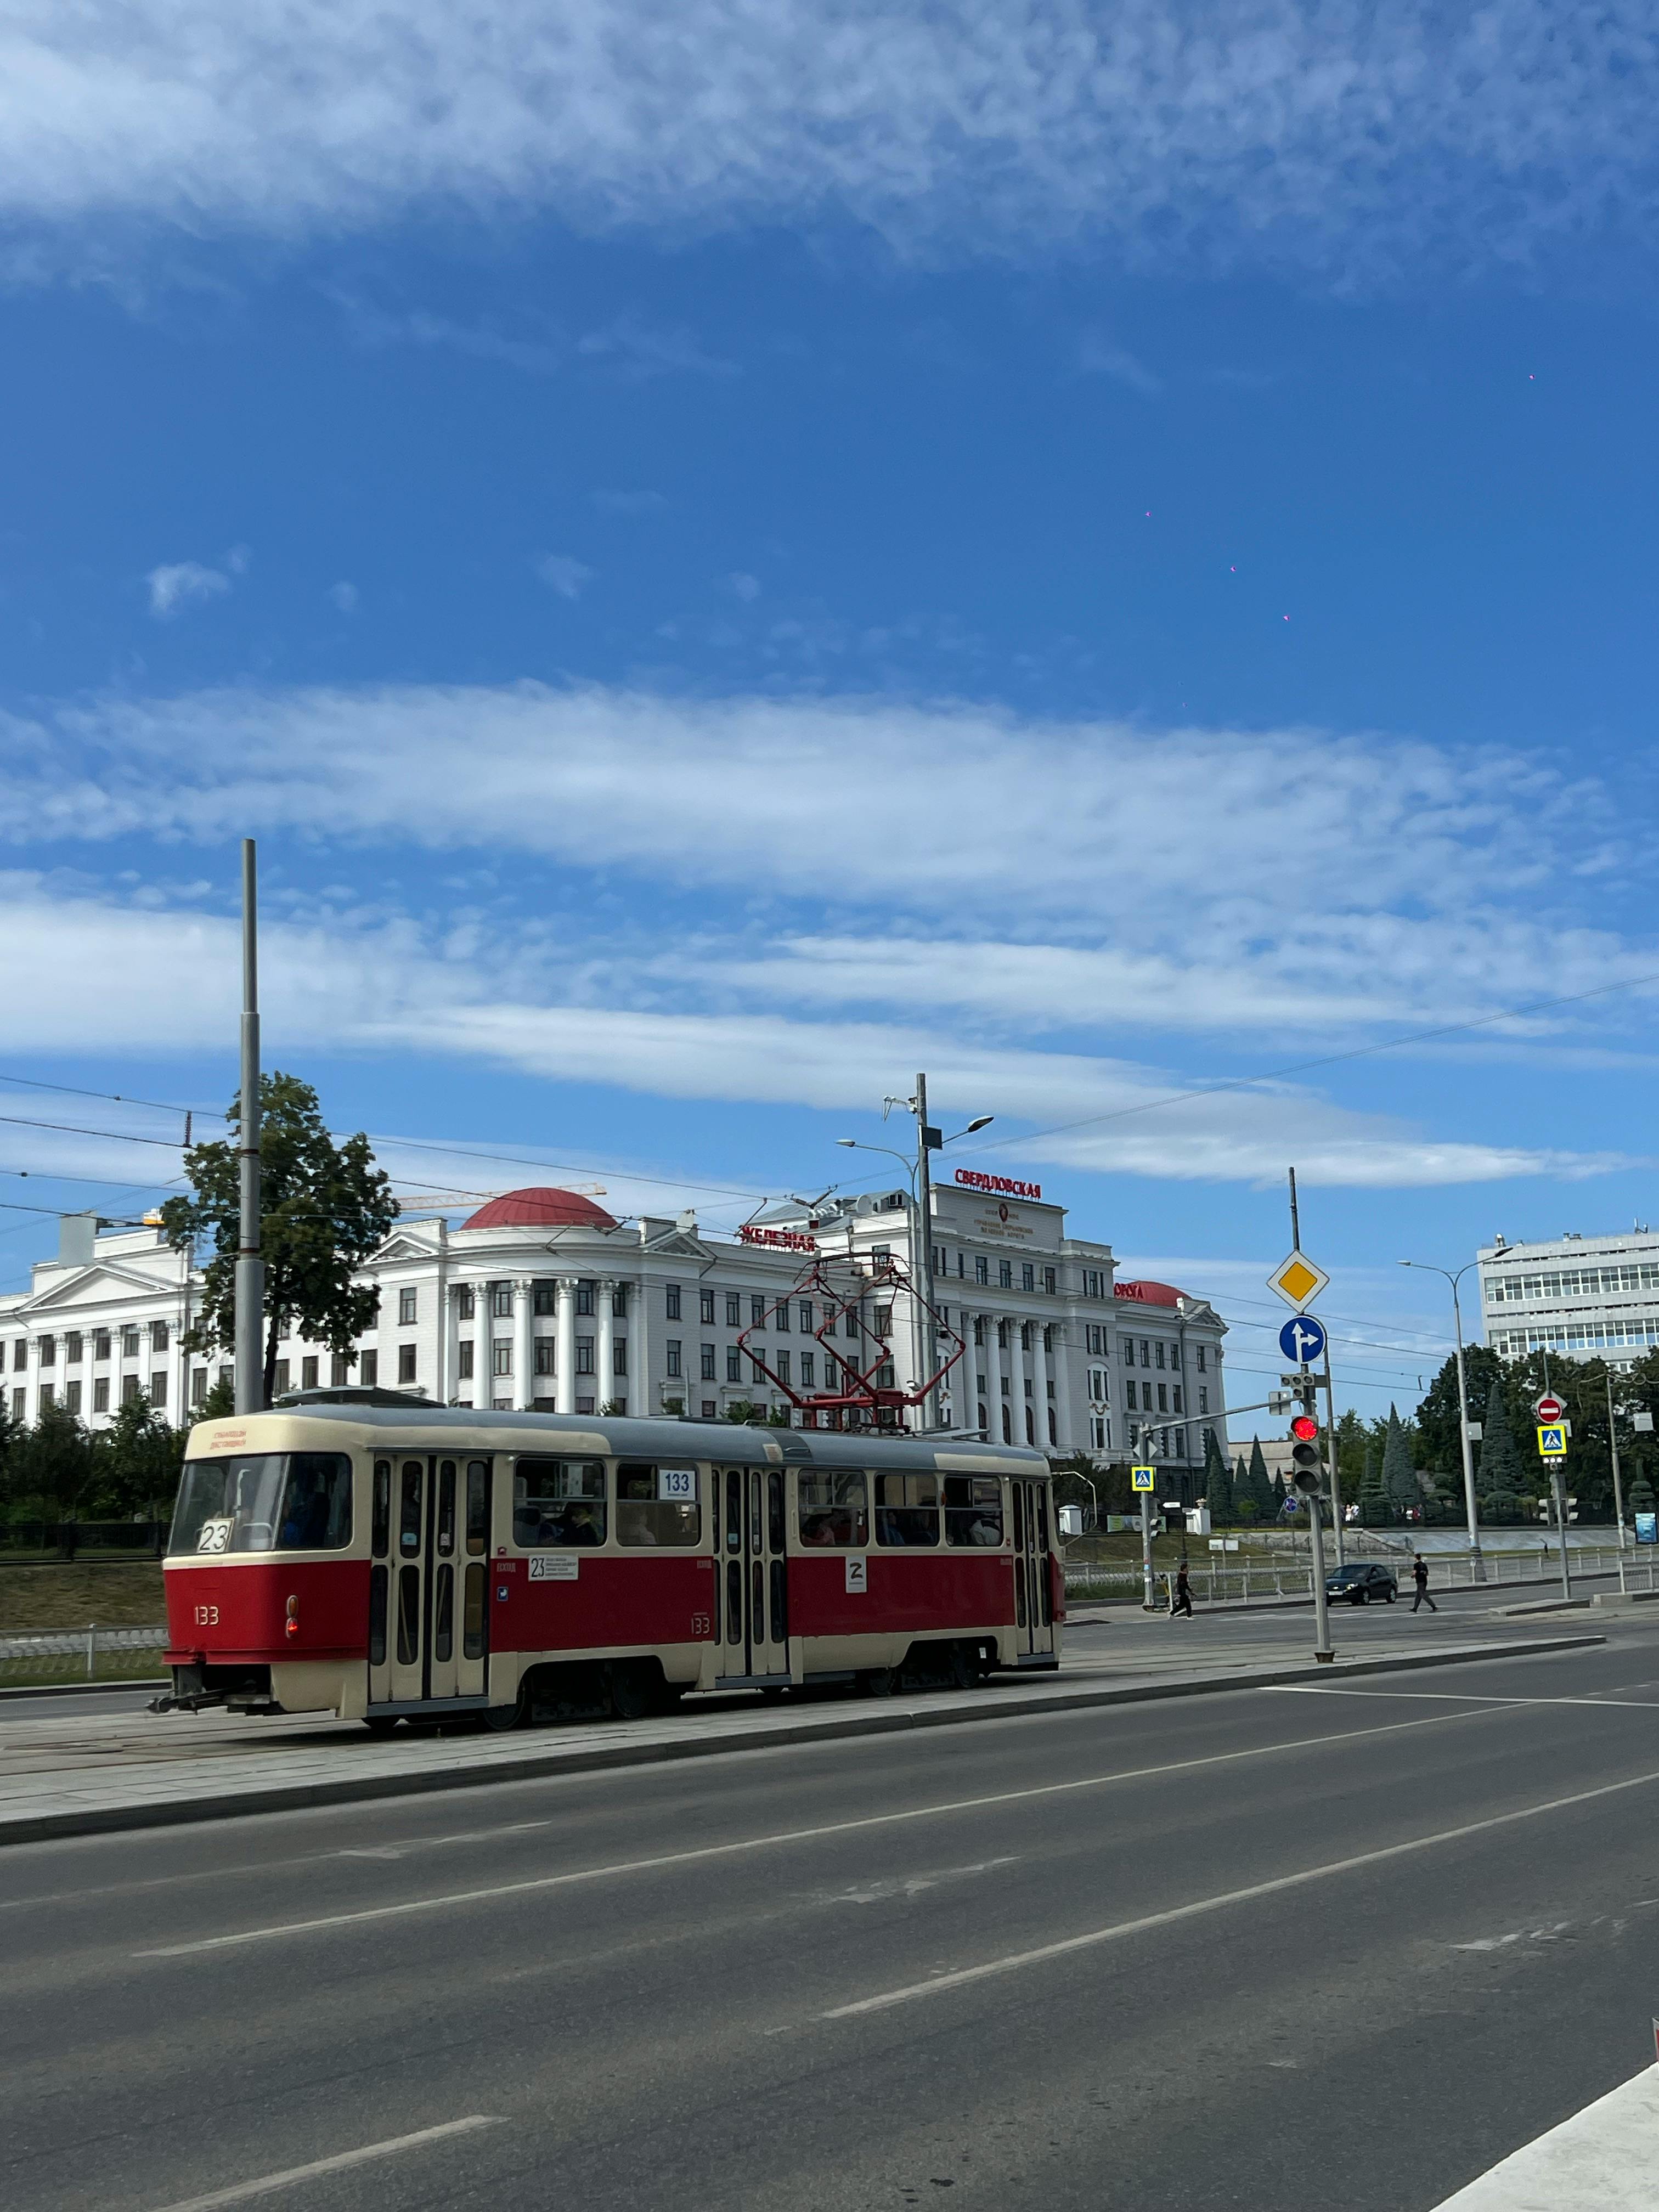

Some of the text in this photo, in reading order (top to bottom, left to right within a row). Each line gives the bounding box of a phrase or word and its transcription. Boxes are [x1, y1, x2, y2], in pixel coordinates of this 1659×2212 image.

[955, 1169, 1041, 1199] СВЕРДЛОВСКАЯ
[741, 1226, 815, 1252] ЖЕЛЕЗНАЯ
[1114, 1283, 1143, 1299] ОРОГА
[665, 1473, 689, 1492] 133
[200, 1525, 228, 1550] 23
[531, 1558, 545, 1577] 23
[849, 1562, 863, 1579] 2
[195, 1606, 219, 1626] 133
[691, 1617, 710, 1634] 133
